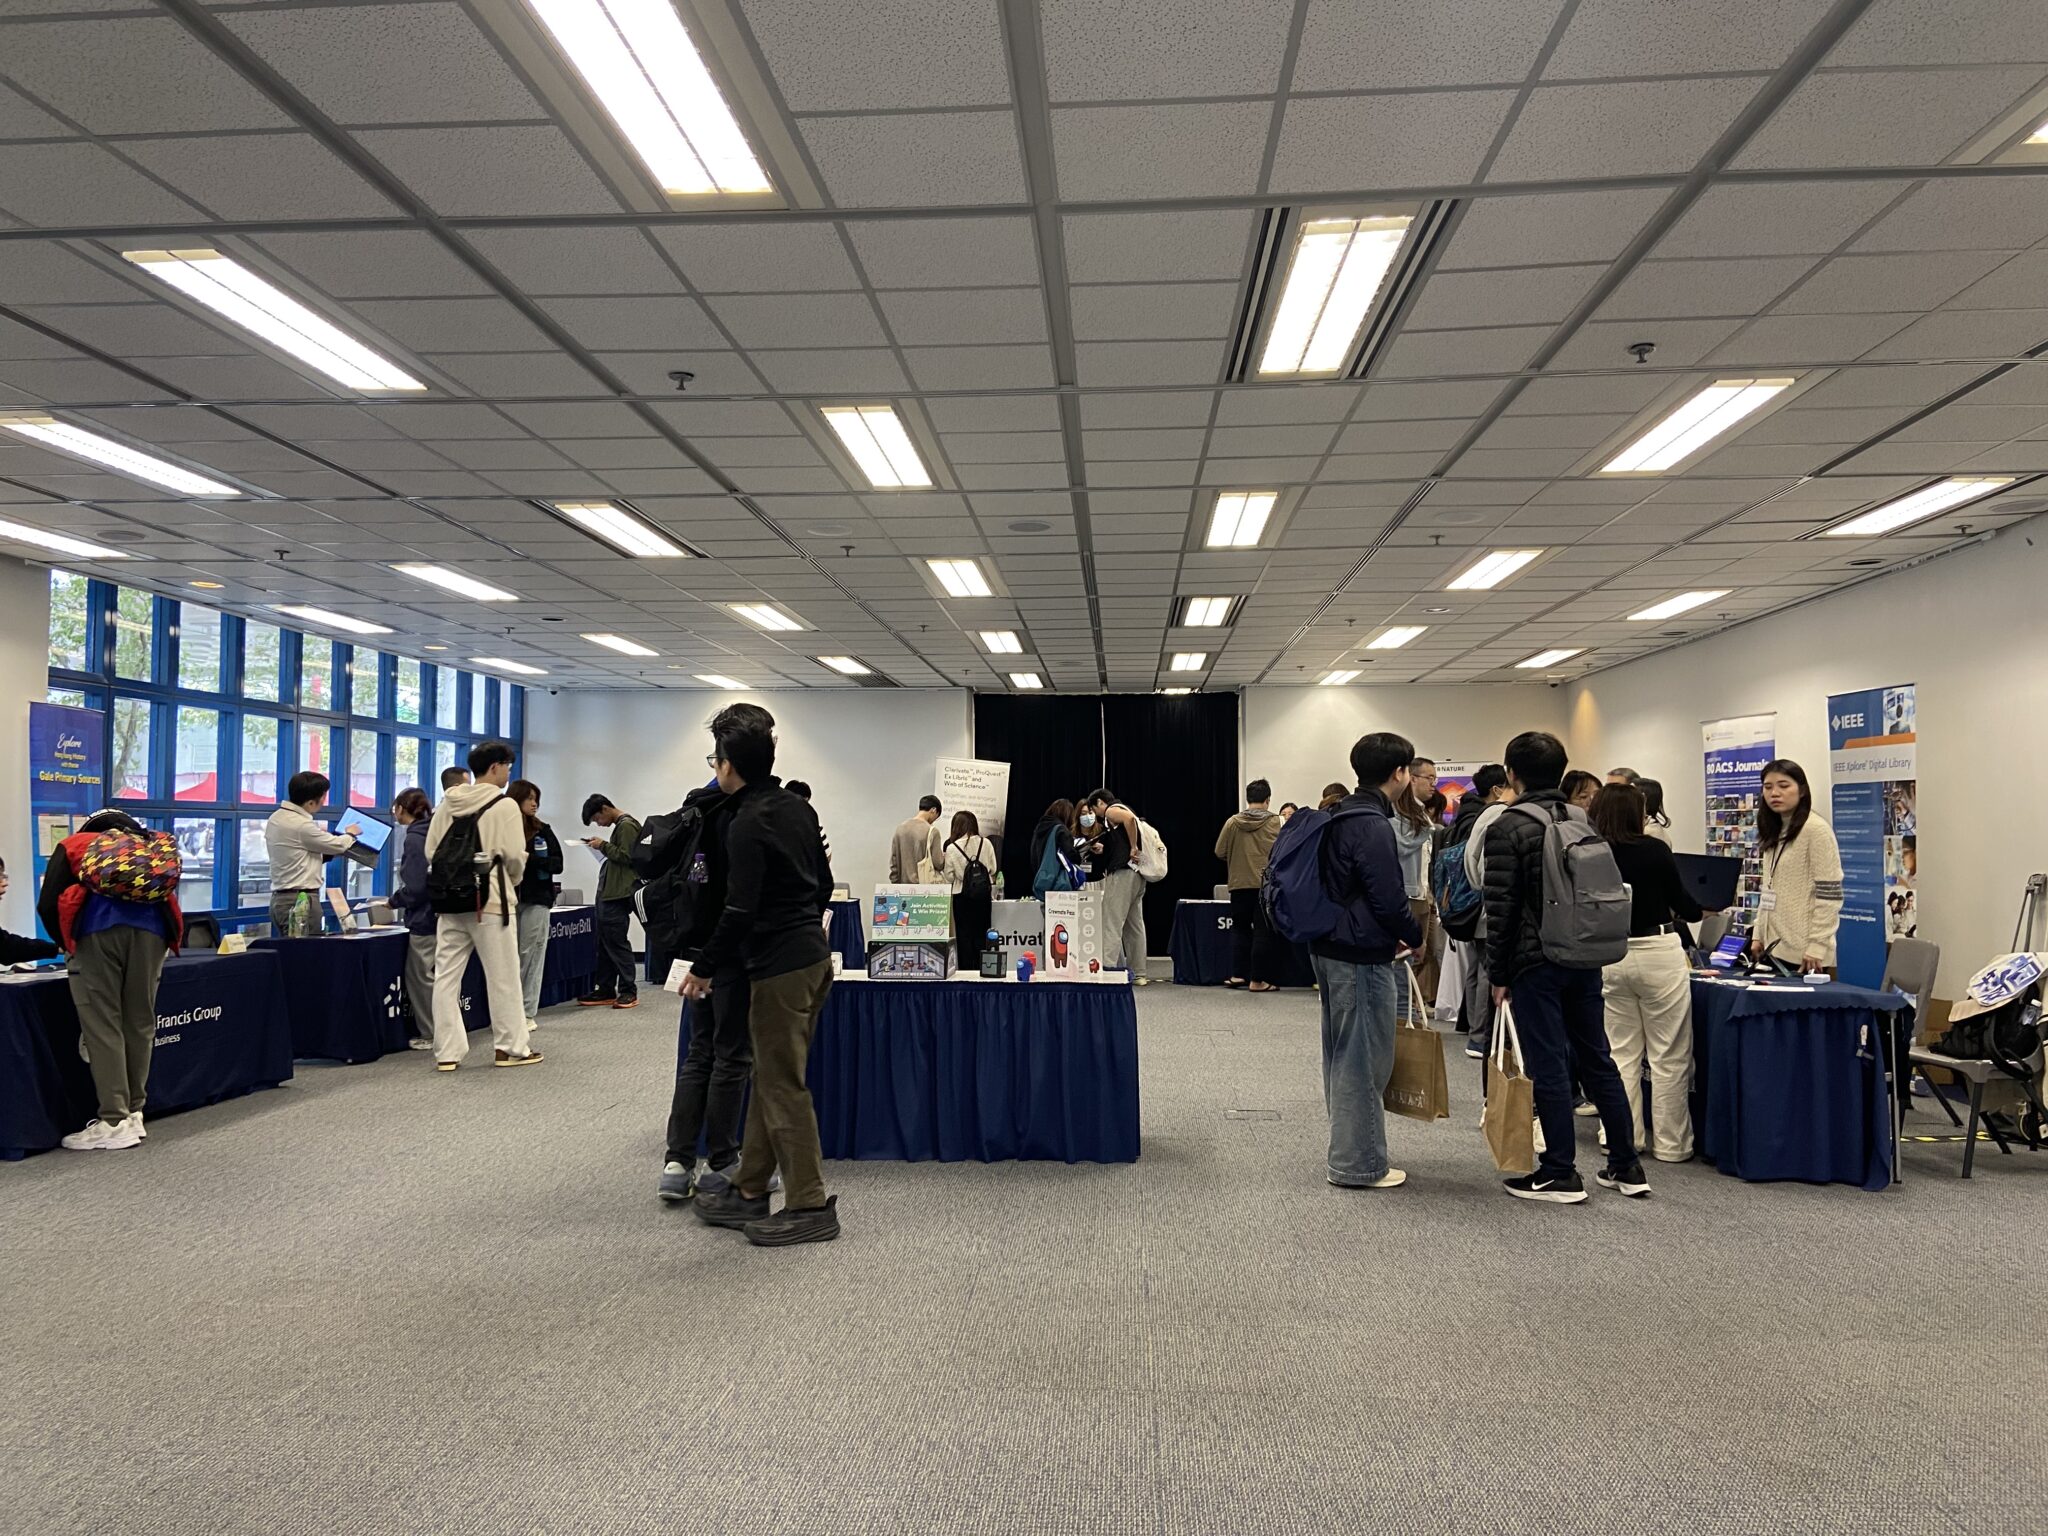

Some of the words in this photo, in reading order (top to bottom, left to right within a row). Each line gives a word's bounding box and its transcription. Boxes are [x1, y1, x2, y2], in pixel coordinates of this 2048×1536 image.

[1841, 713, 1864, 729] IEEE
[57, 733, 82, 754] Explore
[1706, 763, 1715, 774] 80
[1715, 761, 1733, 774] ACS
[1833, 762, 1846, 772] IEEE
[1869, 758, 1887, 772] Digital
[1888, 757, 1911, 770] Library
[39, 770, 54, 781] Gale
[55, 771, 77, 785] Primary
[78, 773, 101, 785] Sources
[556, 921, 579, 939] Gruyter
[579, 917, 591, 934] Brill
[1217, 916, 1233, 930] SP
[998, 930, 1043, 946] arivat
[156, 1009, 192, 1030] Francis
[192, 1005, 222, 1022] Group
[154, 1033, 181, 1047] business
